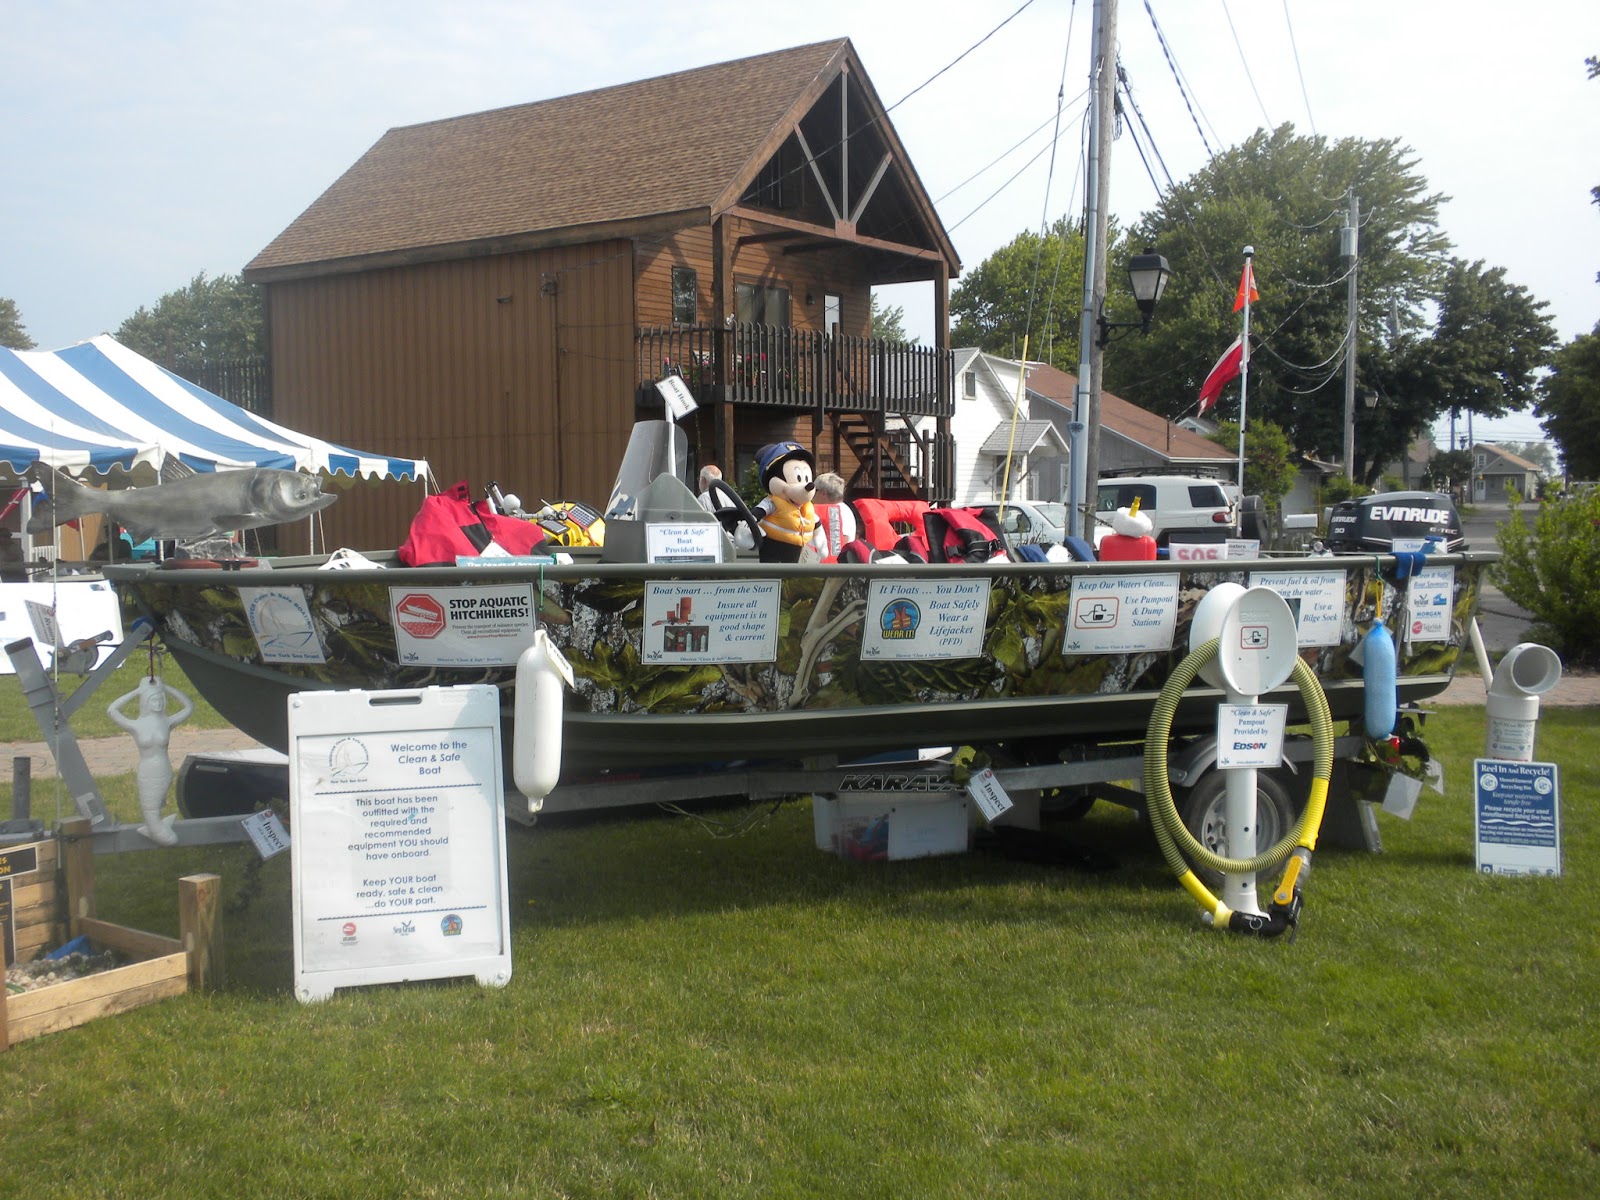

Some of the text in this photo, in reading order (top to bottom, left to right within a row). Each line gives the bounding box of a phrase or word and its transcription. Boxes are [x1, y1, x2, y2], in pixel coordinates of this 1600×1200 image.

[1370, 506, 1449, 524] EVINRUDE
[1429, 527, 1458, 535] E-TEC
[1078, 581, 1097, 591] Keep
[1100, 581, 1115, 589] Our
[1118, 580, 1142, 589] Waters
[1260, 577, 1287, 585] Prevent
[1287, 577, 1300, 587] fuel
[1303, 577, 1308, 585] &
[1319, 576, 1336, 586] from
[653, 587, 673, 595] Boat
[675, 586, 701, 595] Smart
[714, 586, 736, 596] from
[738, 585, 750, 594] the
[752, 585, 773, 593] Start
[879, 586, 888, 594] It
[890, 585, 919, 594] Floats
[936, 585, 952, 593] You
[954, 584, 980, 593] Don't
[449, 596, 528, 609] STOP AQUATIC
[717, 600, 757, 609] Insure all
[929, 599, 980, 610] Boat Safely
[1125, 596, 1173, 605] Use Pumpout
[1132, 607, 1164, 616] & Dump
[1314, 603, 1326, 611] Use
[451, 608, 529, 620] HITCHHIKERS!
[705, 612, 748, 622] equipment
[750, 611, 757, 619] is
[939, 613, 960, 622] Wear
[1303, 613, 1338, 623] Bilge Sock
[719, 622, 765, 632] good shape
[1132, 618, 1161, 627] Stations
[882, 630, 915, 639] WEAR IT!
[929, 626, 974, 636] Lifejacket
[939, 638, 963, 646] (PFD)
[391, 740, 467, 753] Welcome to the
[1233, 742, 1267, 750] EDSON
[398, 753, 461, 764] Clean & Safe
[419, 766, 441, 775] Boat
[1481, 764, 1498, 773] Reel
[1499, 765, 1507, 773] In
[1520, 766, 1550, 777] Recycle!
[356, 794, 438, 807] This boat has been
[984, 783, 1005, 811] Inspect
[362, 805, 435, 817] outfitted with the
[370, 817, 428, 828] required and
[263, 821, 285, 848] Inspect
[364, 827, 432, 839] recommended
[348, 837, 449, 851] equipment YOU should
[366, 850, 432, 861] have onboard.
[363, 874, 437, 888] Keep YOUR boat
[388, 887, 407, 896] safe
[409, 886, 416, 894] &
[417, 884, 443, 894] clean
[388, 897, 414, 907] YOUR
[415, 896, 436, 906] part.
